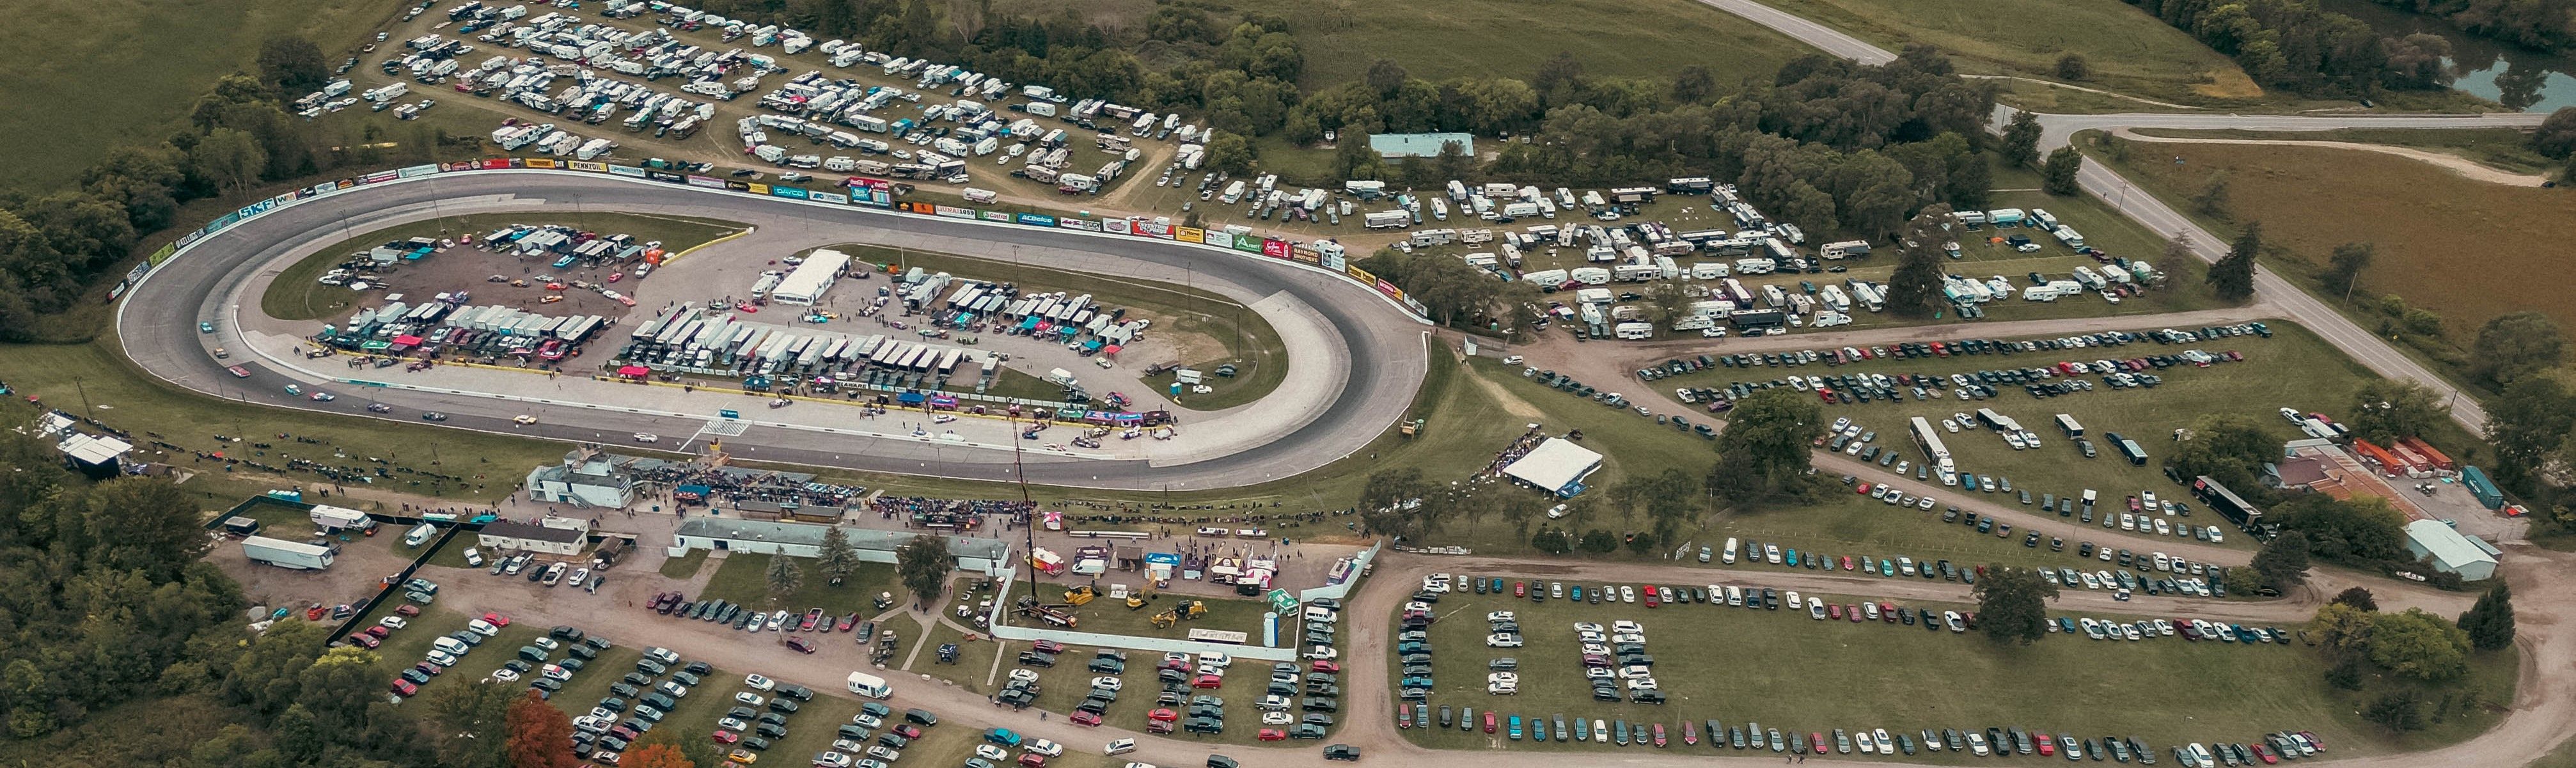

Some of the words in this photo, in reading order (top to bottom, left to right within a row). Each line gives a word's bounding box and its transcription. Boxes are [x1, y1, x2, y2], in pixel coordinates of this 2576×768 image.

[573, 162, 602, 171] PENNZOIL
[277, 193, 295, 203] WM
[240, 199, 273, 218] SKF
[1021, 215, 1053, 223] ACDelco
[1294, 247, 1319, 258] RAYMOND
[1294, 253, 1319, 263] BROTHERS
